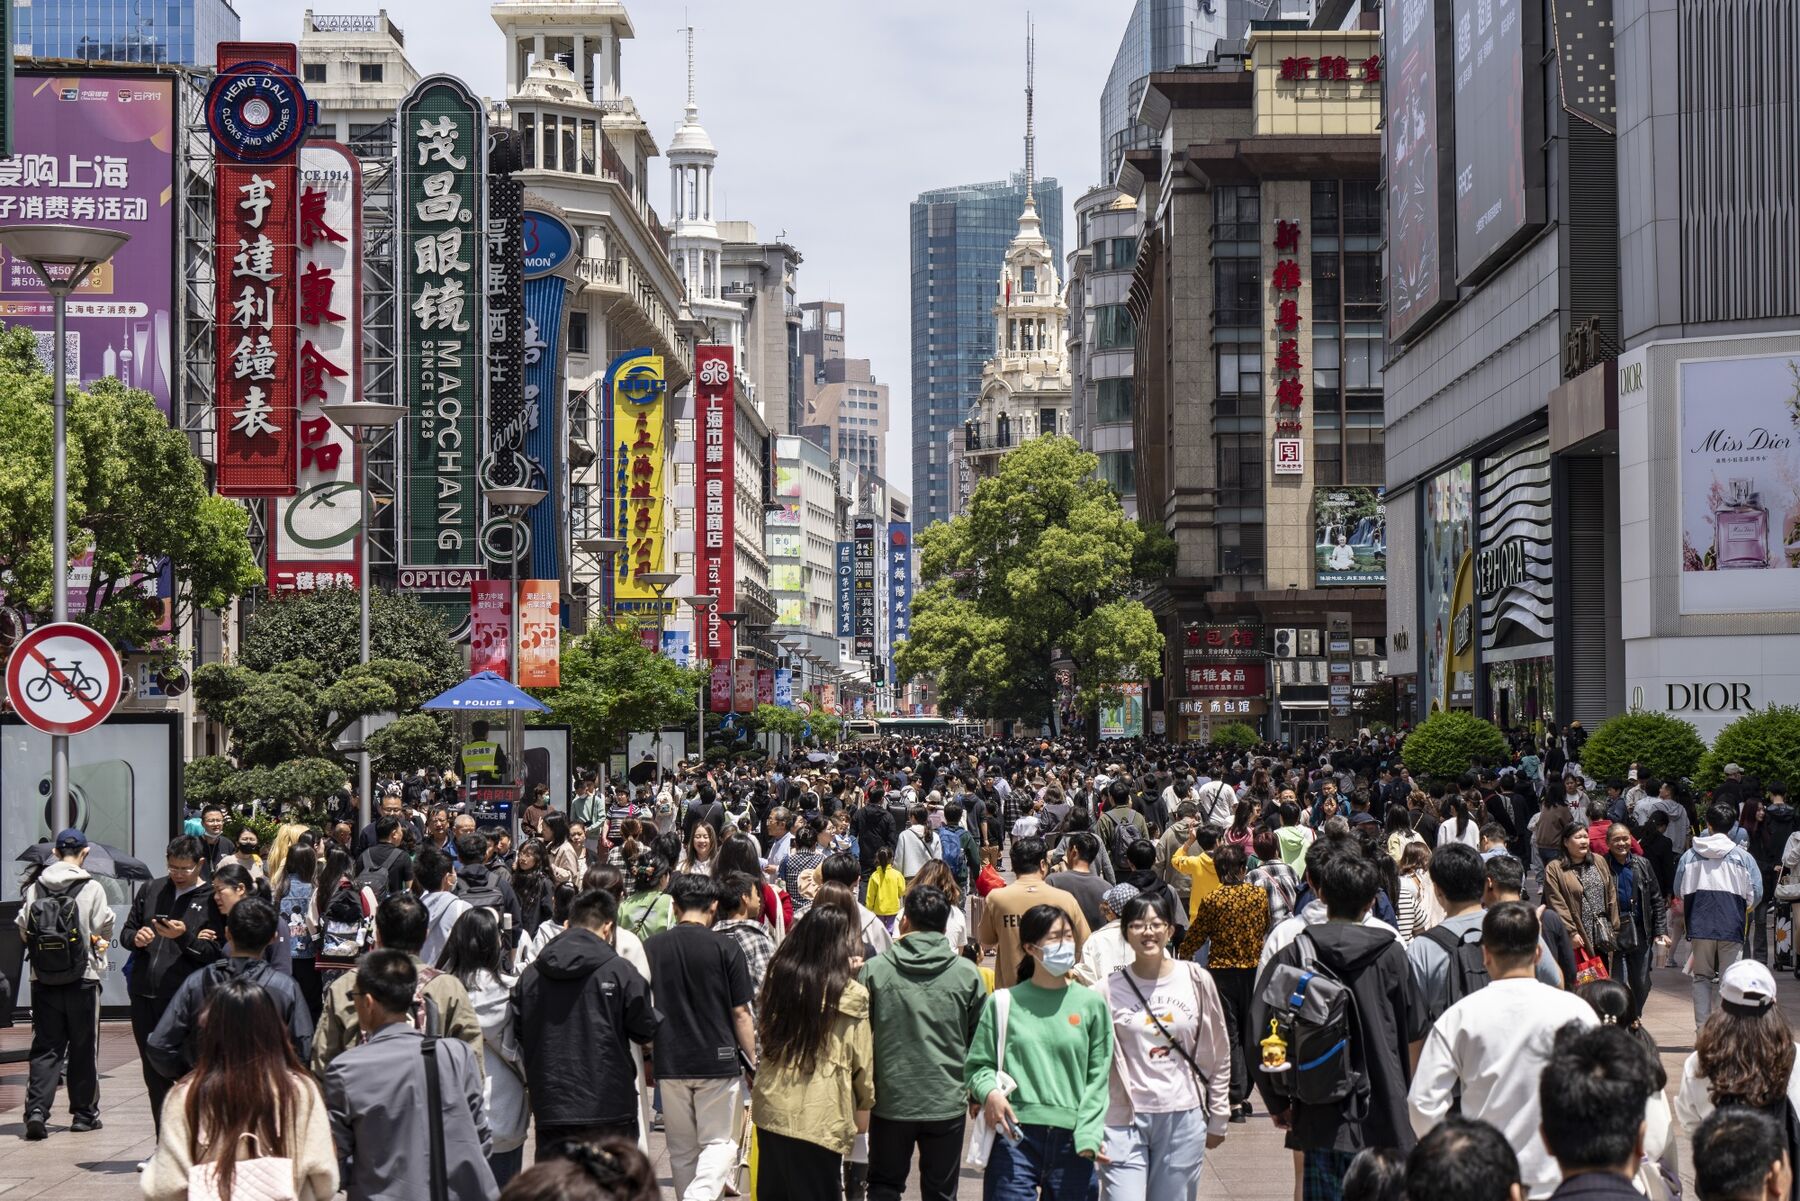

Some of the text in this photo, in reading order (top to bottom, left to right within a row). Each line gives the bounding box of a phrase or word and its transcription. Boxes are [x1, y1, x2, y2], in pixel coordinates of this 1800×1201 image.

[224, 77, 290, 104] HENG DALI
[222, 107, 290, 146] CLOCKS AND WATCHES
[324, 170, 349, 182] 1914
[411, 115, 471, 332] 茂昌眼镜
[421, 340, 434, 439] SINCE 1923
[1620, 362, 1643, 396] DIOR
[437, 340, 462, 550] MAOCHANG
[1691, 427, 1792, 453] Miss Dior
[706, 395, 724, 548] 上海市第一食品商店
[1476, 540, 1523, 595] SEPHORA
[708, 557, 721, 648] First Fodhall
[1190, 668, 1246, 682] 新雅食品
[1666, 683, 1755, 711] DIOR
[1166, 996, 1193, 1020] FORZA
